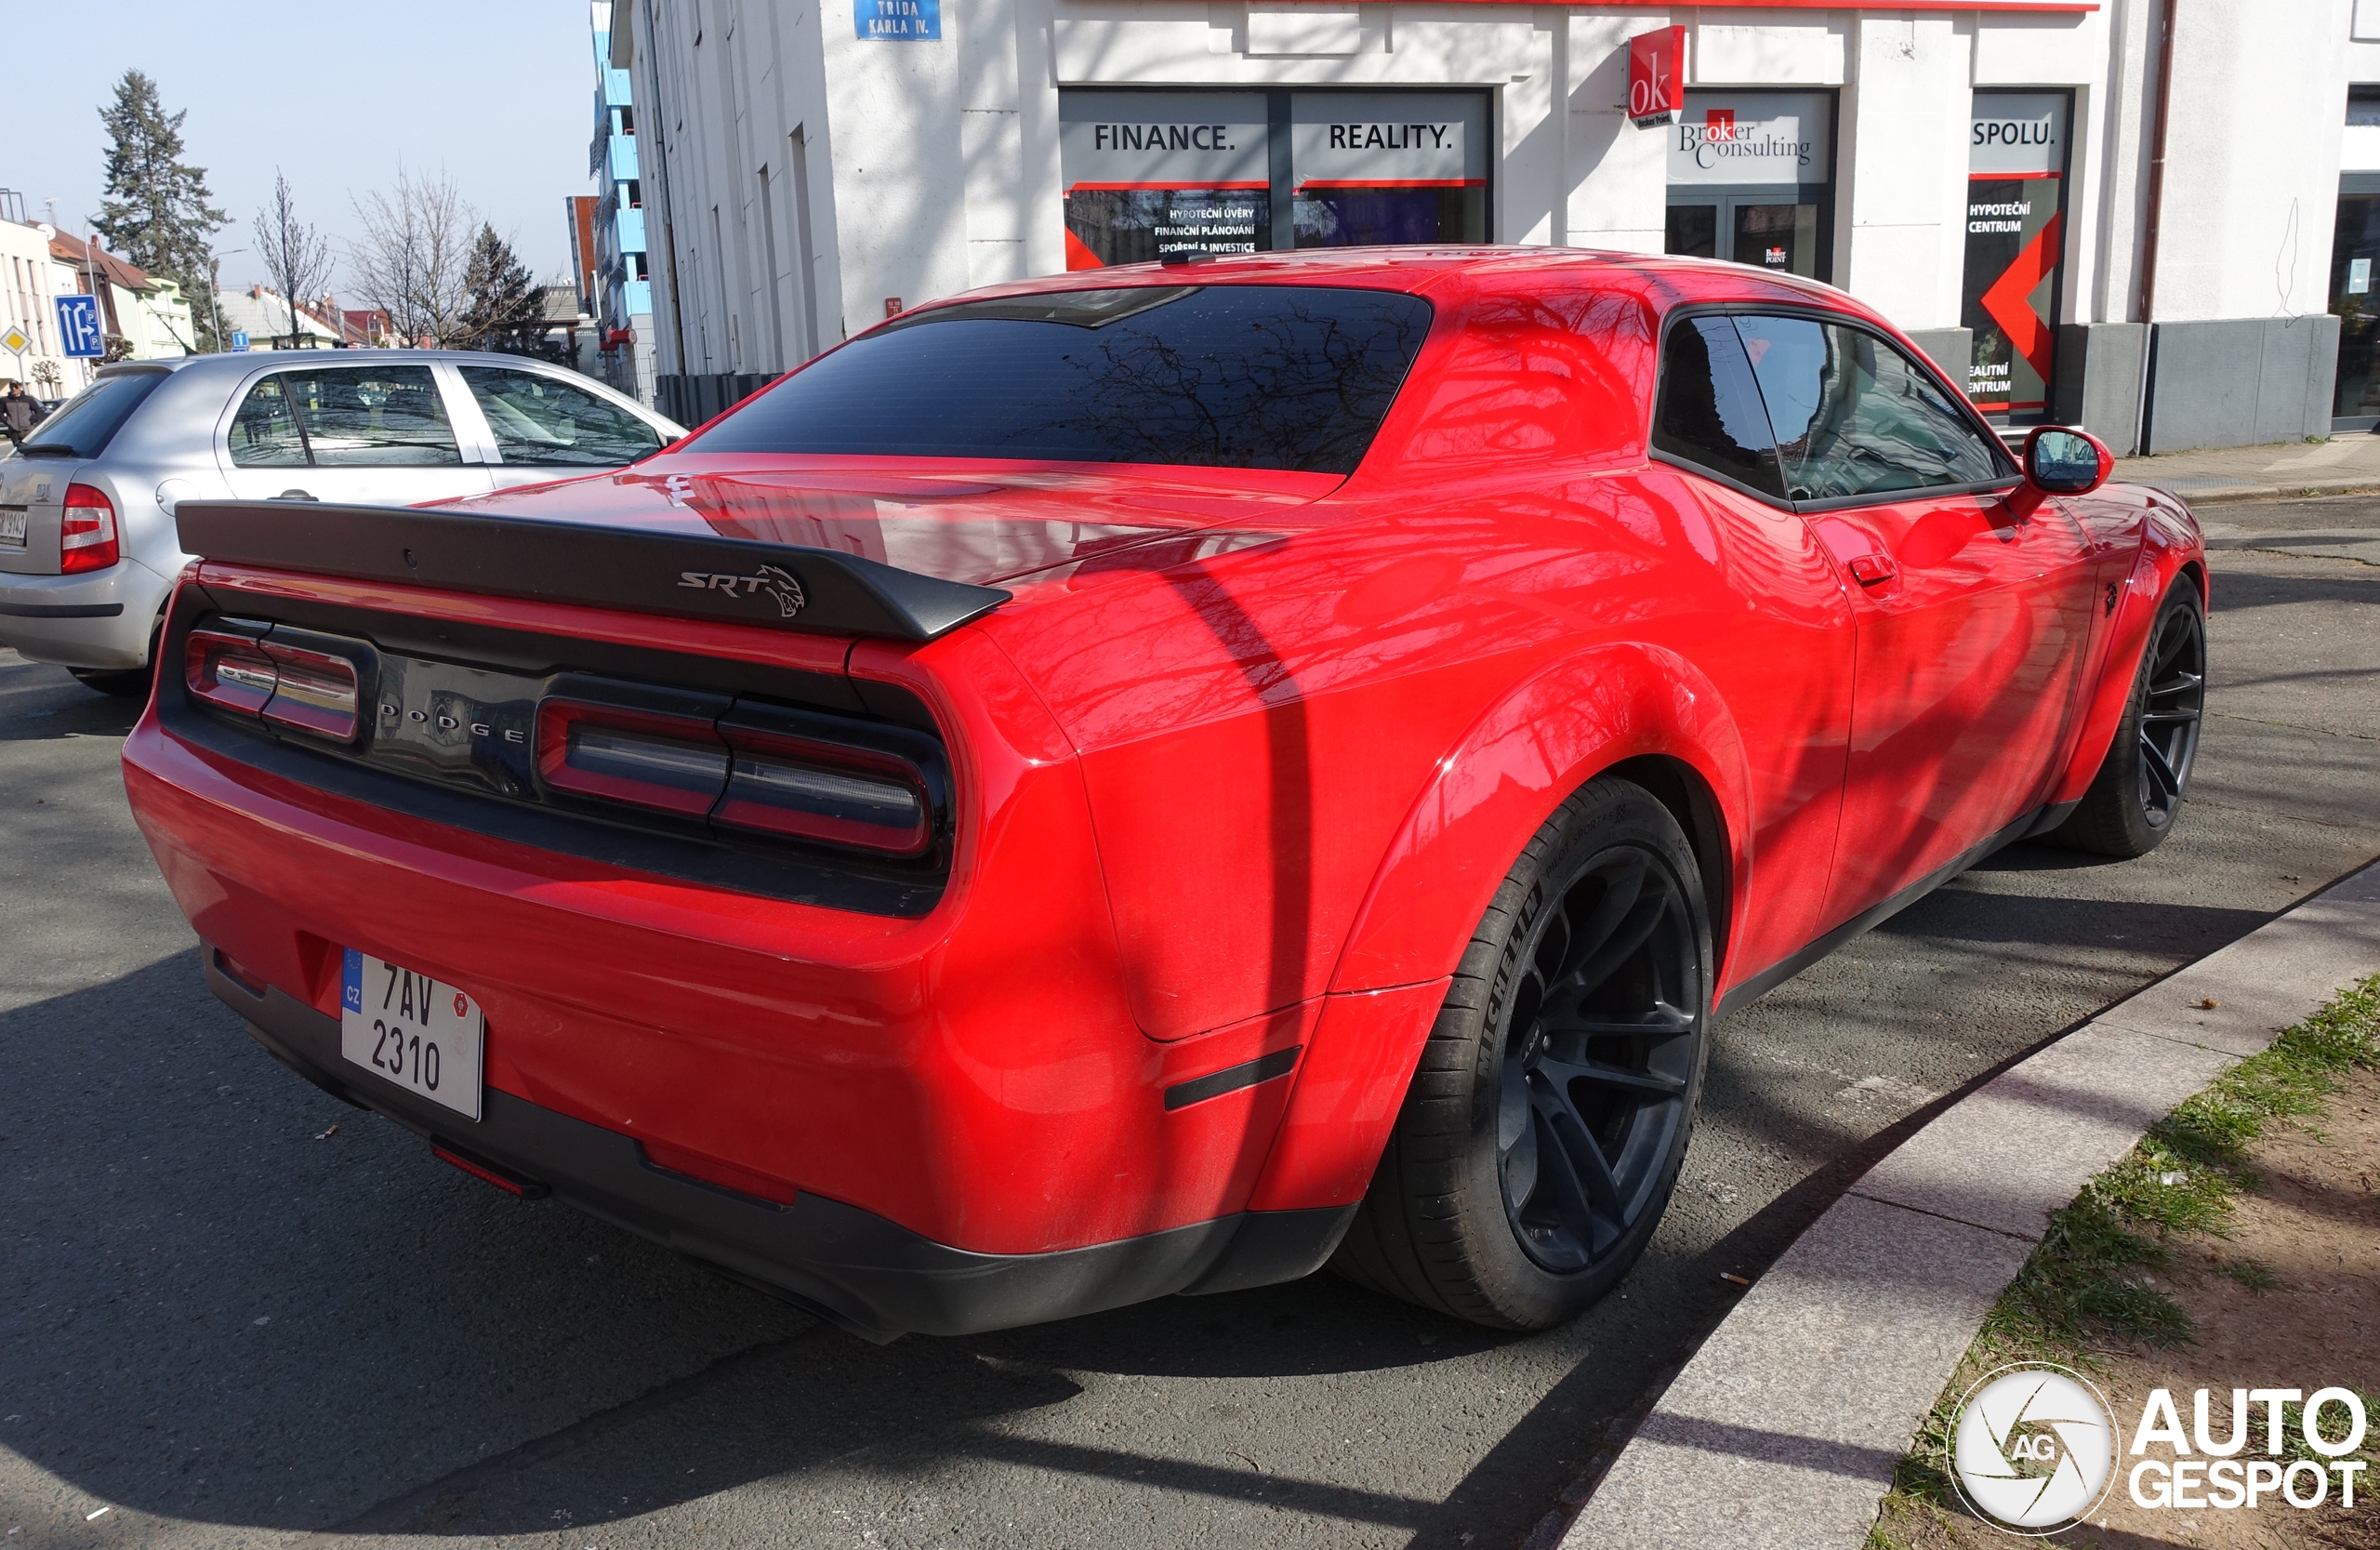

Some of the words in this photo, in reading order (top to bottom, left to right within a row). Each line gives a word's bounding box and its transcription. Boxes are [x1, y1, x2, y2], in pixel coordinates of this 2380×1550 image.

[868, 19, 908, 34] KARLA
[915, 20, 930, 34] IV.
[1630, 51, 1670, 115] ok
[1094, 125, 1236, 151] FINANCE.
[1329, 125, 1452, 149] REALITY.
[1678, 117, 1754, 152] Broker
[1973, 122, 2055, 145] SPOLU.
[1696, 134, 1811, 170] Consulting
[1170, 206, 1223, 219] HYPOTEČNÍ
[1223, 206, 1254, 219] ÚVĚRY
[1969, 200, 2031, 216] HYPOTEČNÍ
[1155, 224, 1199, 236] FINANČNÍ
[1201, 224, 1255, 235] PLÁNOVÁNÍ
[1968, 220, 2021, 233] CENTRUM
[1200, 243, 1208, 251] &
[1210, 243, 1255, 253] INVESTICE
[1969, 361, 2009, 377] EALITNÍ
[1968, 380, 2012, 393] ENTRUM
[677, 572, 771, 599] SRT
[380, 703, 524, 744] DODGE
[1544, 841, 1571, 880] PILOT
[1571, 815, 1603, 846] SPORT
[382, 960, 433, 1027] 7AV
[1476, 883, 1540, 1080] MICHELIN
[346, 985, 360, 1005] CZ
[372, 1018, 441, 1092] 2310
